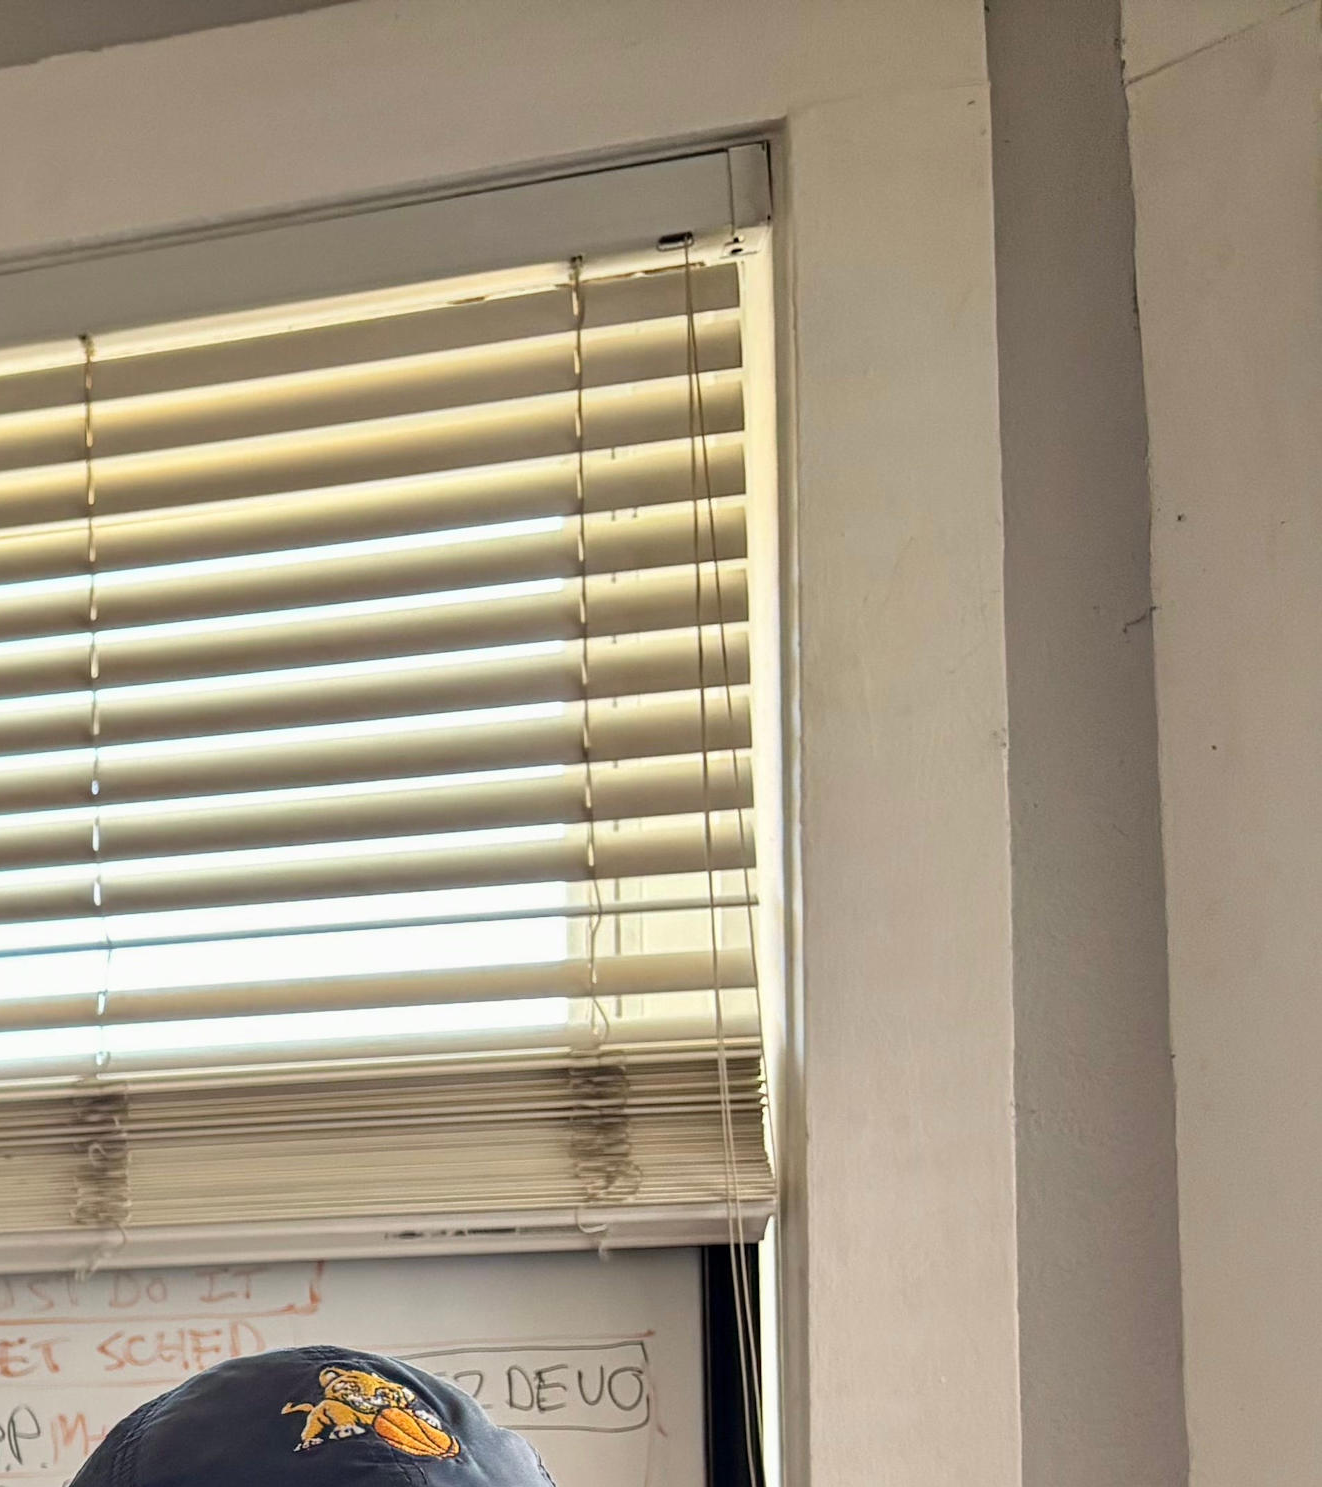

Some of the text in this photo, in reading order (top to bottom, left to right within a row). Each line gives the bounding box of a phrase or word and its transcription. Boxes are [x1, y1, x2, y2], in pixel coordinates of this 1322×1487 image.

[108, 1272, 168, 1309] DO
[198, 1267, 268, 1302] IT
[96, 1319, 267, 1371] SCHED
